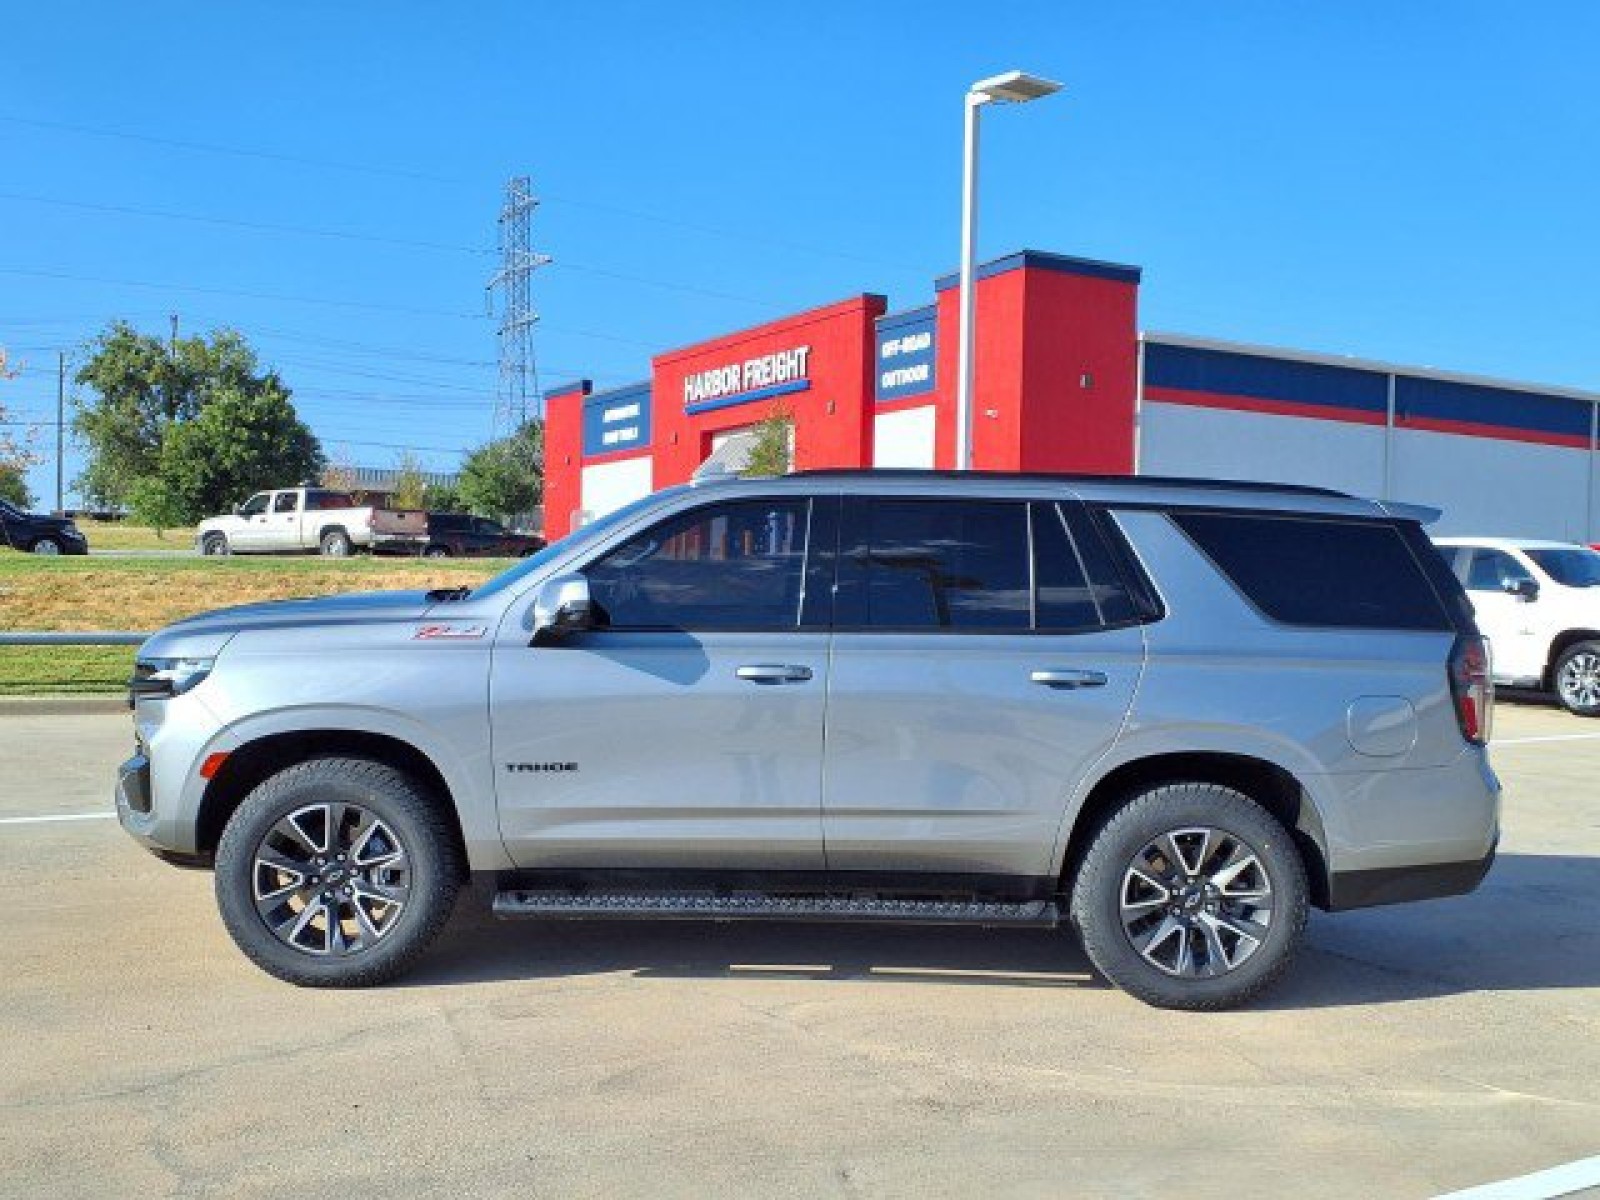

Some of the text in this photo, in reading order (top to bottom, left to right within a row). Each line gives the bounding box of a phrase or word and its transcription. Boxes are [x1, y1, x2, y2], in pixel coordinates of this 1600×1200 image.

[684, 344, 811, 403] HARBOR FREIGHT
[506, 762, 578, 773] TAHOE
